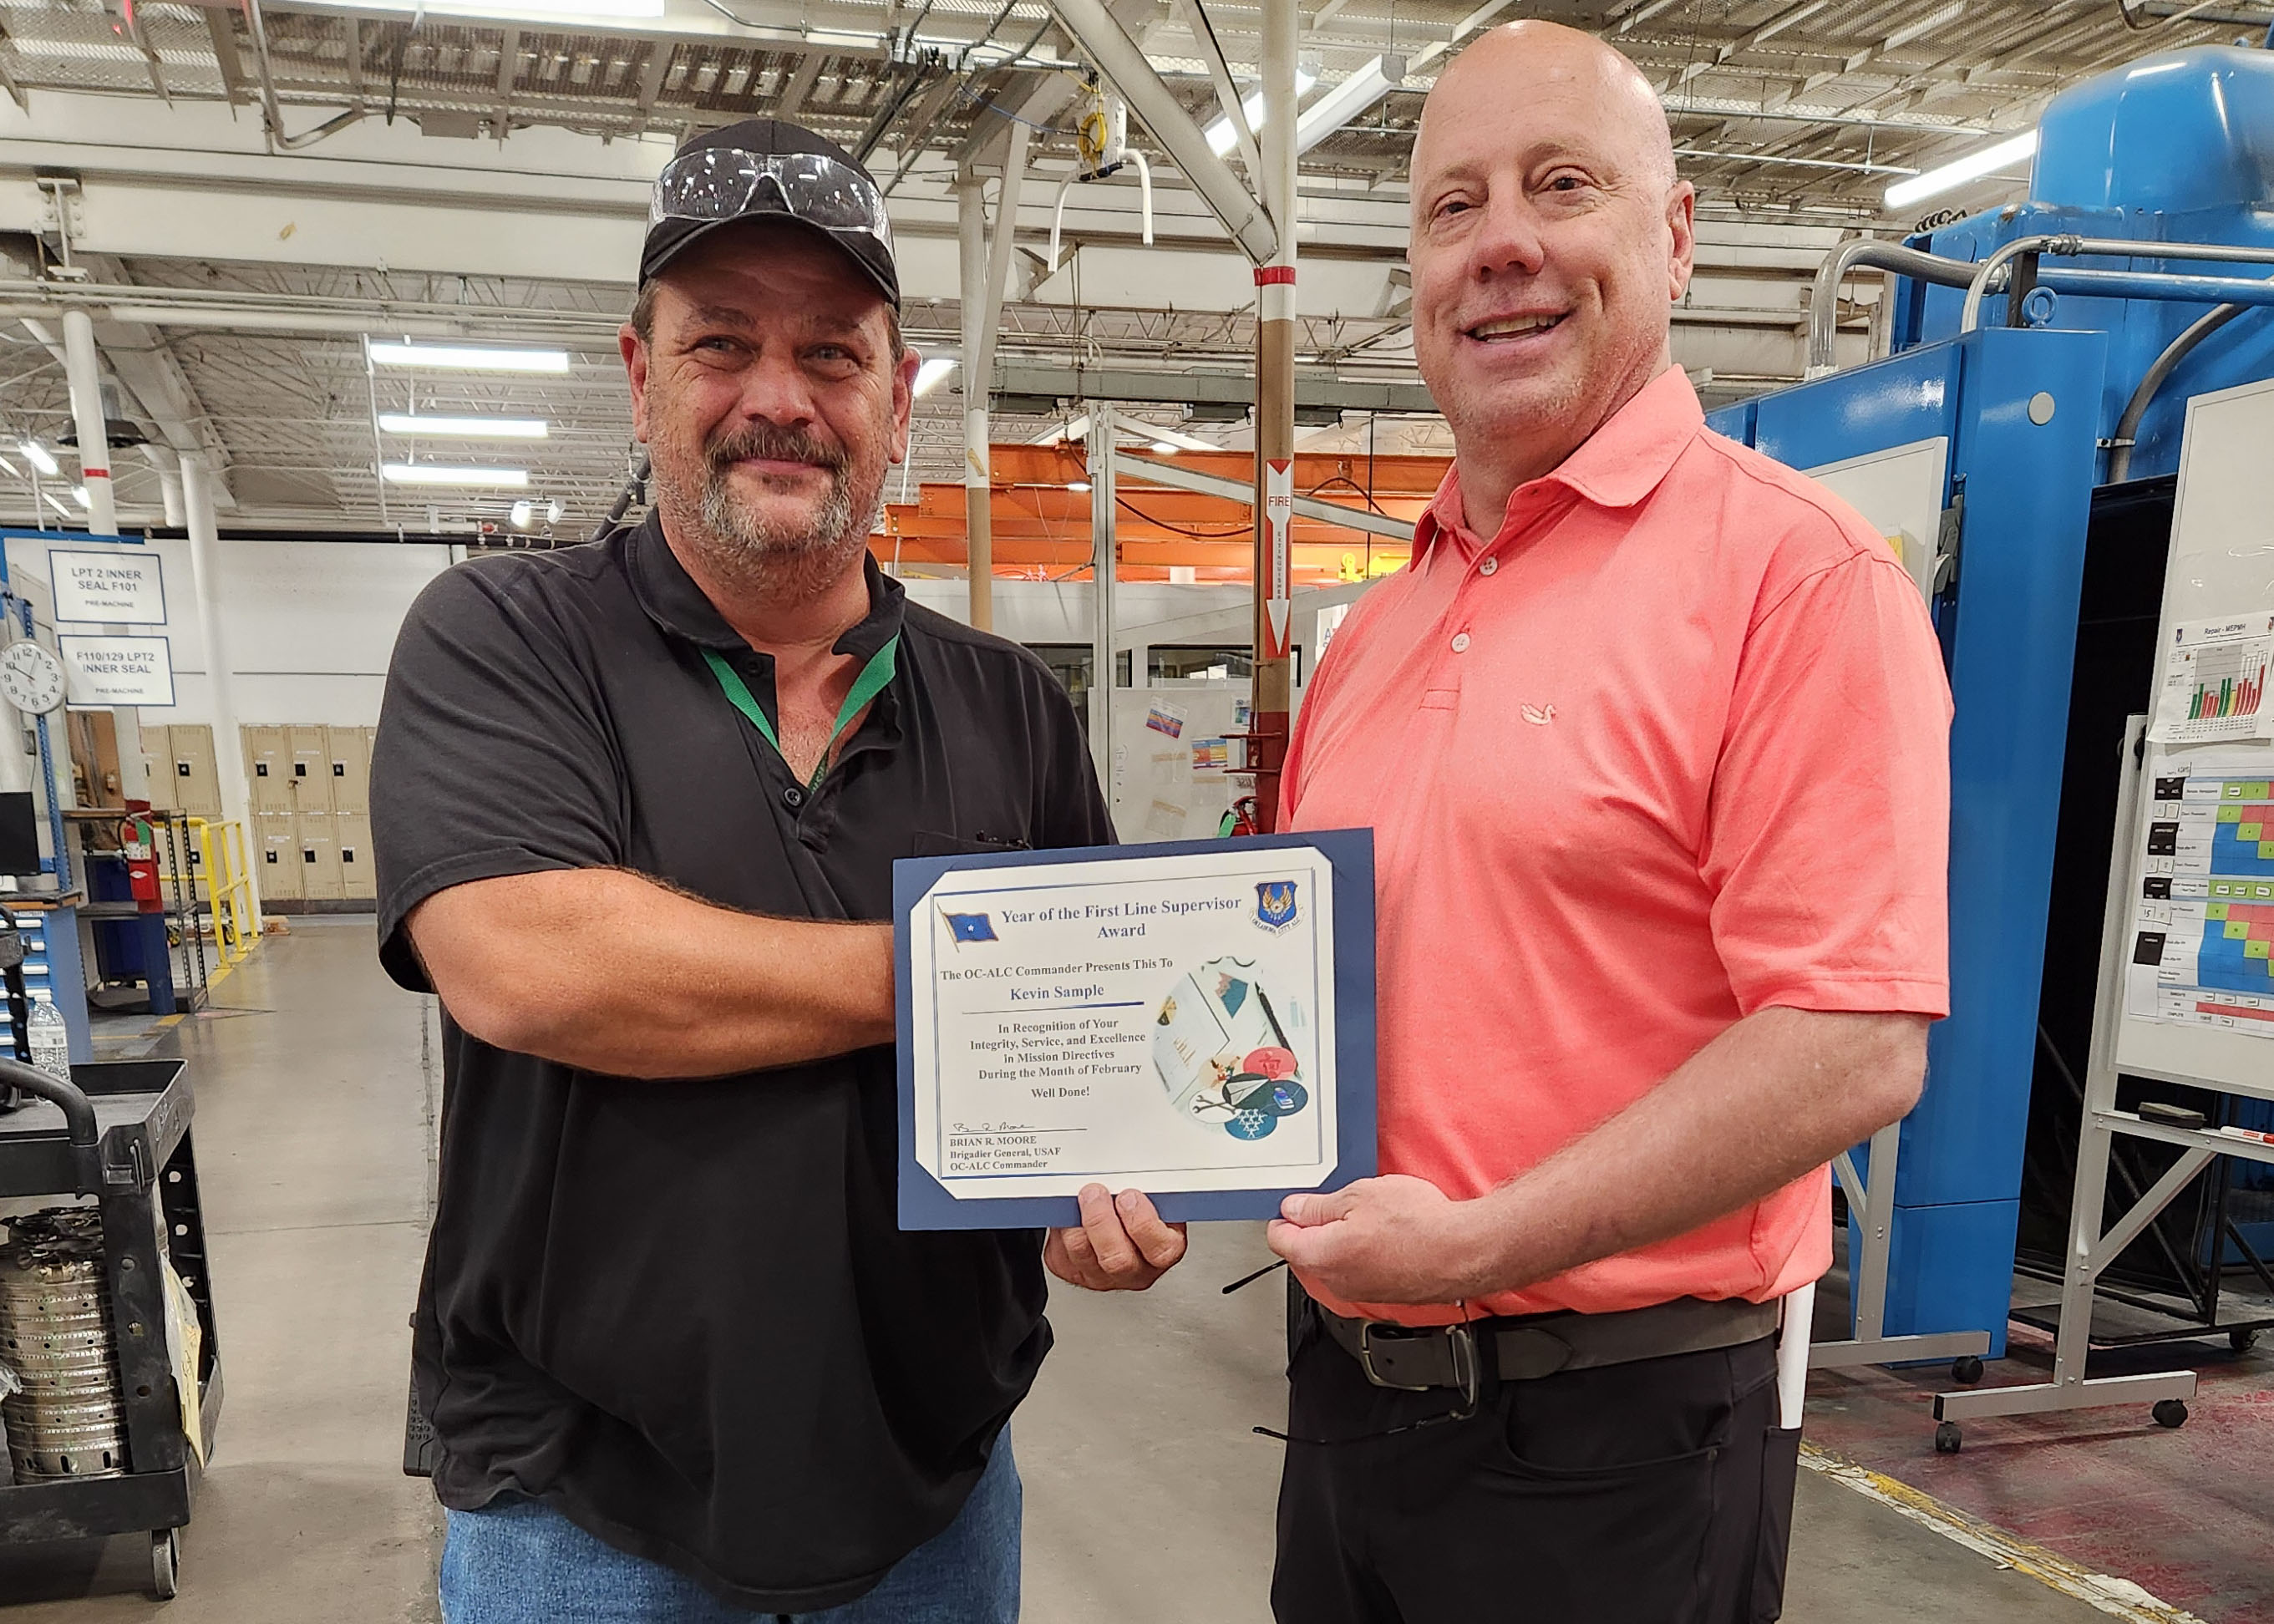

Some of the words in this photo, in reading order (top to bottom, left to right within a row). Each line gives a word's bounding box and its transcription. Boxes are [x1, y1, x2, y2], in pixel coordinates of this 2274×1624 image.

[1268, 495, 1291, 507] FIRE
[71, 567, 93, 578] LPT
[97, 569, 103, 578] 2
[106, 570, 142, 581] INNER
[78, 580, 109, 591] SEAL
[112, 581, 137, 591] F101
[84, 600, 135, 609] PRE-MACHINE
[13, 652, 20, 660] 11
[22, 647, 33, 657] 12
[76, 652, 124, 662] F110/129
[127, 652, 155, 662] LPT2
[5, 661, 15, 670] 10
[45, 661, 52, 670] 2
[83, 663, 119, 674] INNER
[121, 664, 151, 674] SEAL
[3, 673, 12, 683] 9
[51, 672, 58, 683] 3
[10, 686, 18, 694] 8
[49, 685, 56, 693] 4
[31, 698, 39, 707] 6
[42, 693, 50, 702] 5
[1001, 909, 1035, 924] Year
[1038, 908, 1054, 922] of
[1058, 906, 1080, 920] the
[1085, 903, 1119, 918] First
[1124, 902, 1157, 916] Line
[1161, 897, 1242, 916] Supervisor
[1097, 923, 1146, 939] Award
[940, 970, 961, 981] The
[964, 967, 1013, 980] OC-ALC
[1015, 963, 1084, 977] Commander
[1086, 961, 1130, 973] Presents
[1133, 958, 1157, 970] This
[1159, 957, 1174, 968] To
[1010, 987, 1049, 1001] Kevin
[1054, 984, 1104, 1000] Sample
[998, 1023, 1009, 1034] In
[1013, 1021, 1076, 1035] Recognition
[1079, 1019, 1090, 1029] of
[1093, 1018, 1119, 1028] Your
[970, 1039, 1019, 1052] Integrity,
[1022, 1037, 1064, 1048] Service,
[1066, 1035, 1086, 1046] and
[1090, 1033, 1146, 1044] Excellence
[1004, 1054, 1014, 1064] in
[1018, 1052, 1058, 1063] Mission
[1063, 1049, 1114, 1061] Directives
[978, 1068, 1017, 1081] During
[1019, 1068, 1036, 1078] the
[1038, 1066, 1074, 1077] Month
[1078, 1064, 1089, 1076] of
[1091, 1063, 1143, 1076] February
[1031, 1088, 1055, 1099] Well
[1058, 1086, 1090, 1098] Done!
[950, 1138, 982, 1148] BRIAN
[985, 1137, 994, 1146] R.
[997, 1135, 1037, 1146] MOORE
[950, 1149, 992, 1160] Brigadier
[993, 1148, 1032, 1158] General,
[1033, 1146, 1062, 1157] USAF
[950, 1162, 991, 1171] OC-ALC
[992, 1160, 1048, 1170] Commander
